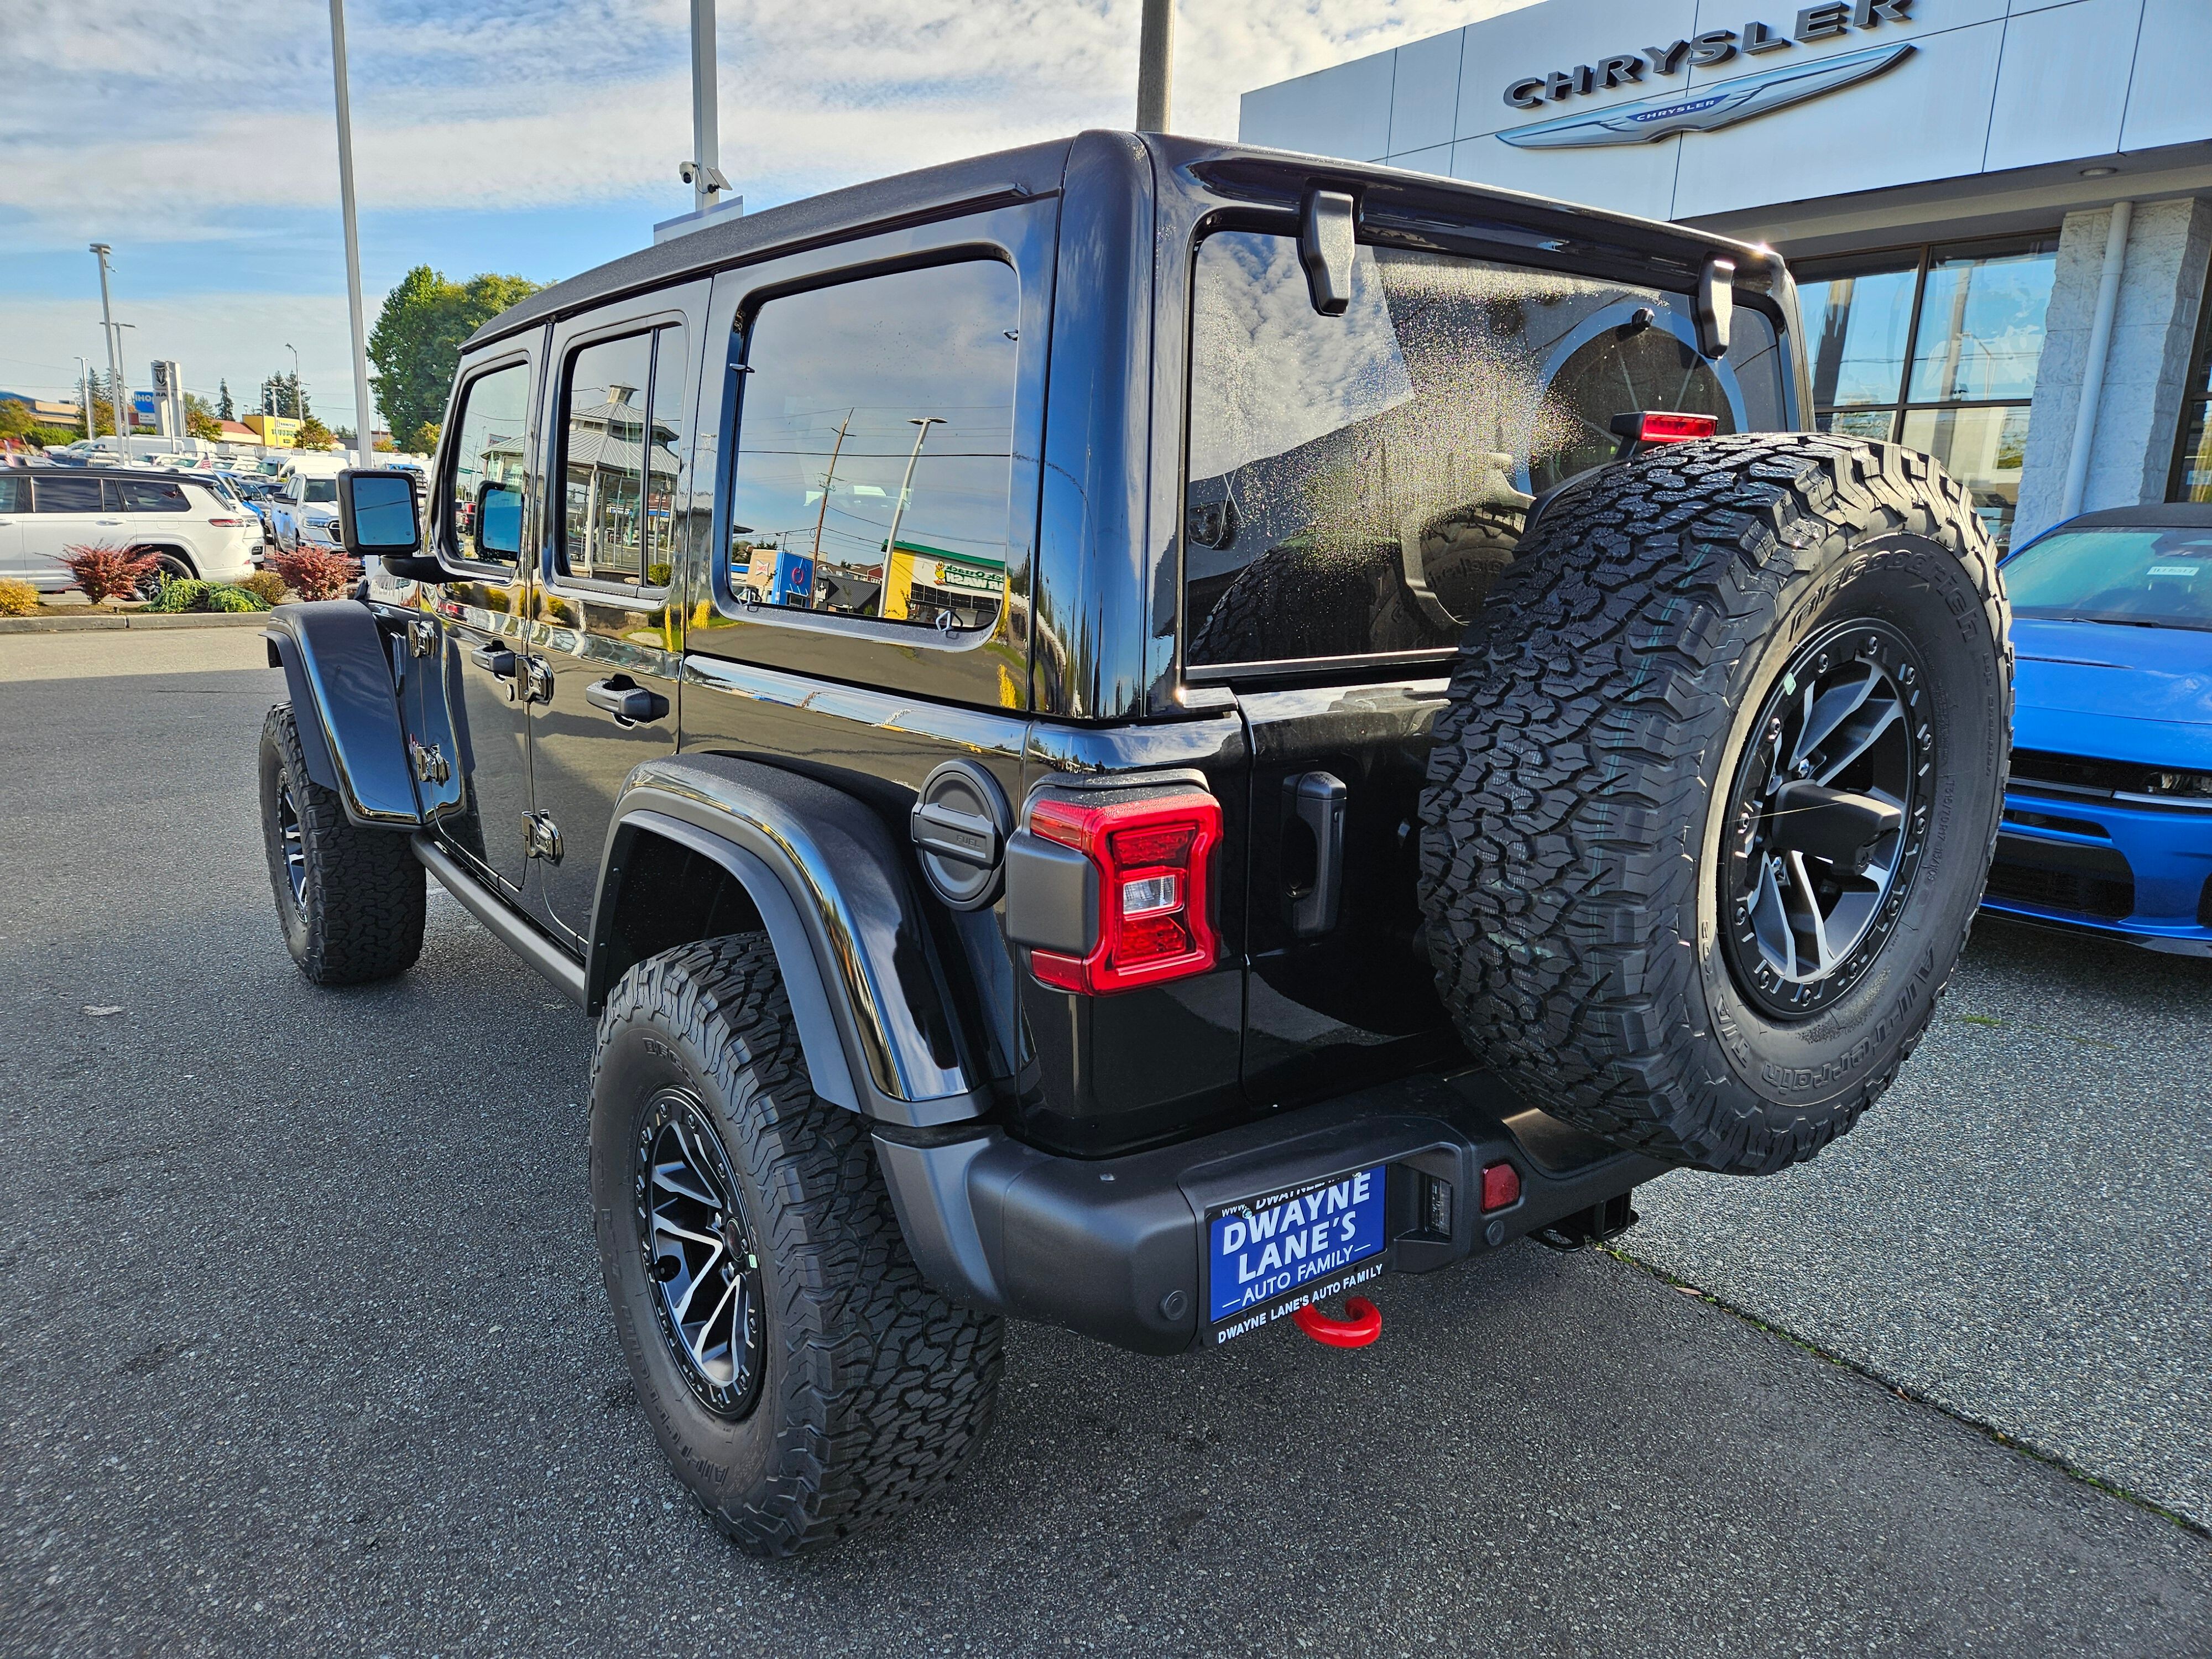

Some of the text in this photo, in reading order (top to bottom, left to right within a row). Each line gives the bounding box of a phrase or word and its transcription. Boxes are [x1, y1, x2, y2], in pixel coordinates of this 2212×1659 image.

[1503, 0, 1912, 108] CHRYSLER
[1636, 98, 1715, 121] CHRYSLER
[134, 393, 154, 402] IHO
[957, 835, 980, 849] FUEL
[1223, 1172, 1371, 1256] DWAYNE
[1239, 1211, 1356, 1284] LANE'S
[1218, 1264, 1383, 1344] DWAYNE LANE'S AUTO FAMILY
[1241, 1244, 1354, 1307] AUTO FAMILY
